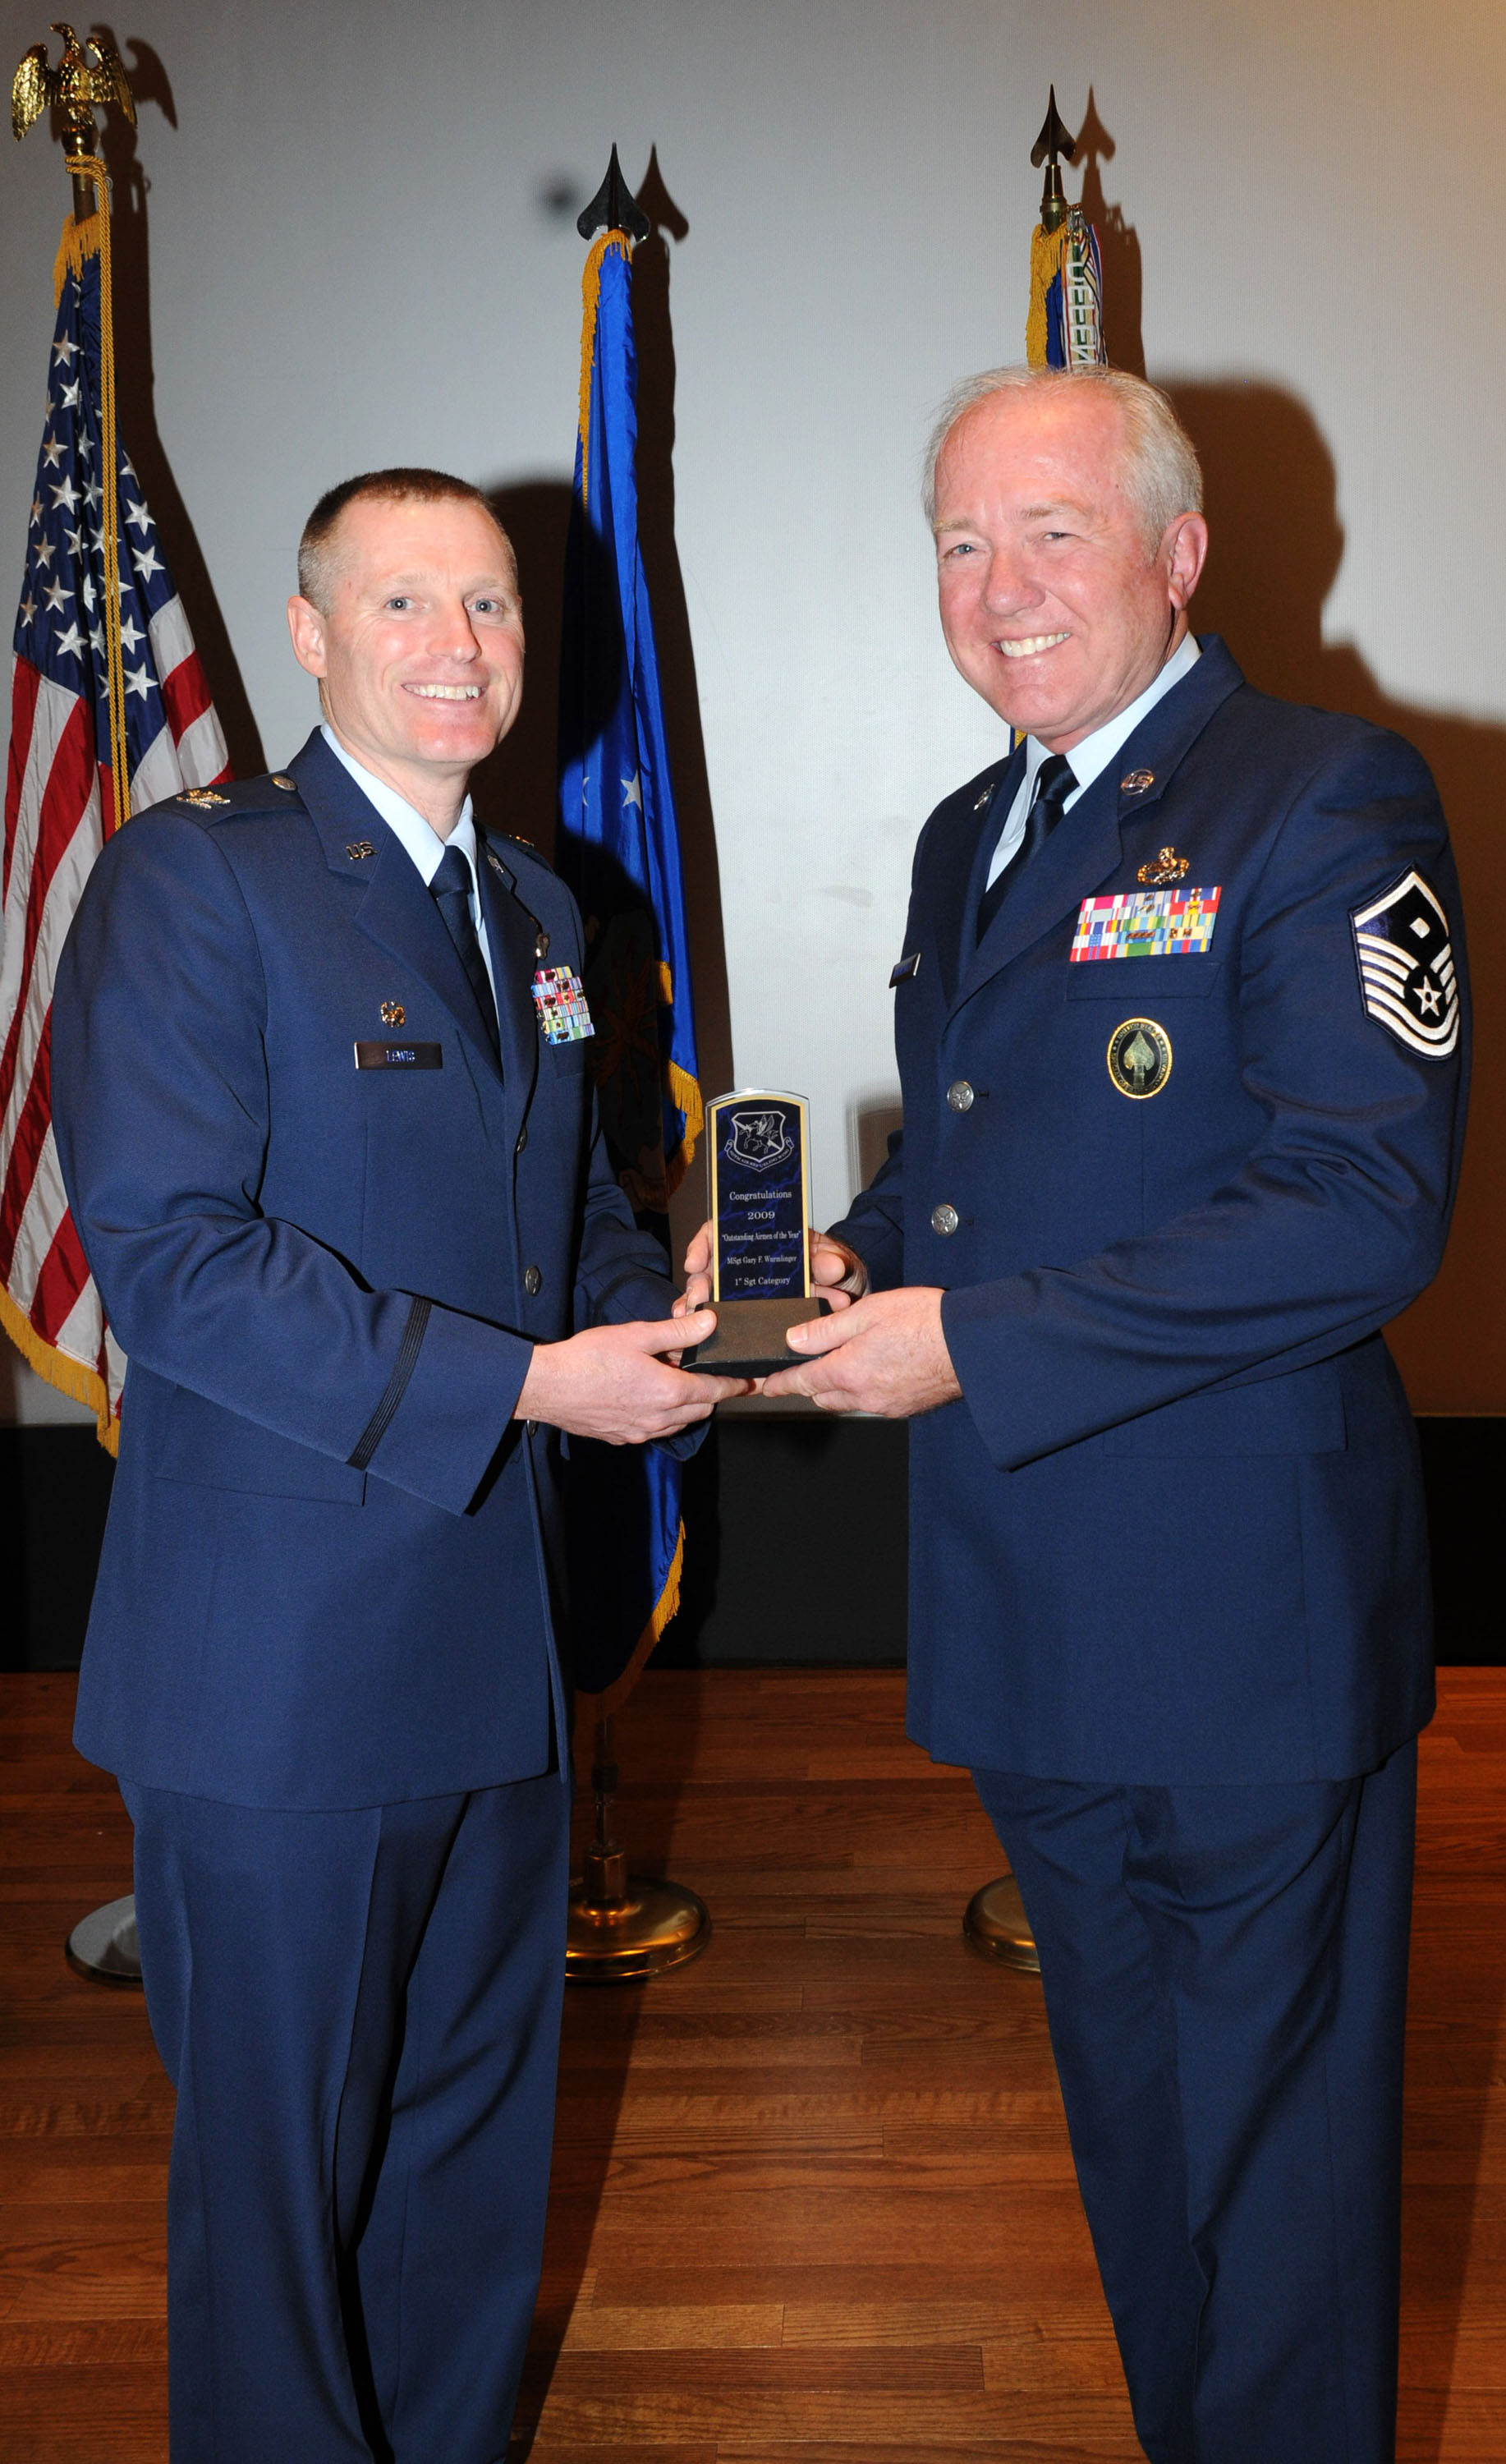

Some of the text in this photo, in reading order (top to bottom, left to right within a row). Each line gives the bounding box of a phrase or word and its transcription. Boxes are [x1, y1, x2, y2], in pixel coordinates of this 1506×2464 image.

[729, 1189, 792, 1202] Congratulations
[747, 1211, 775, 1221] 2009
[773, 1230, 779, 1239] of
[727, 1256, 742, 1266] MSgt
[742, 1256, 756, 1265] Gary
[758, 1255, 764, 1263] F.
[743, 1277, 756, 1287] Sgt
[758, 1276, 791, 1286] Category
